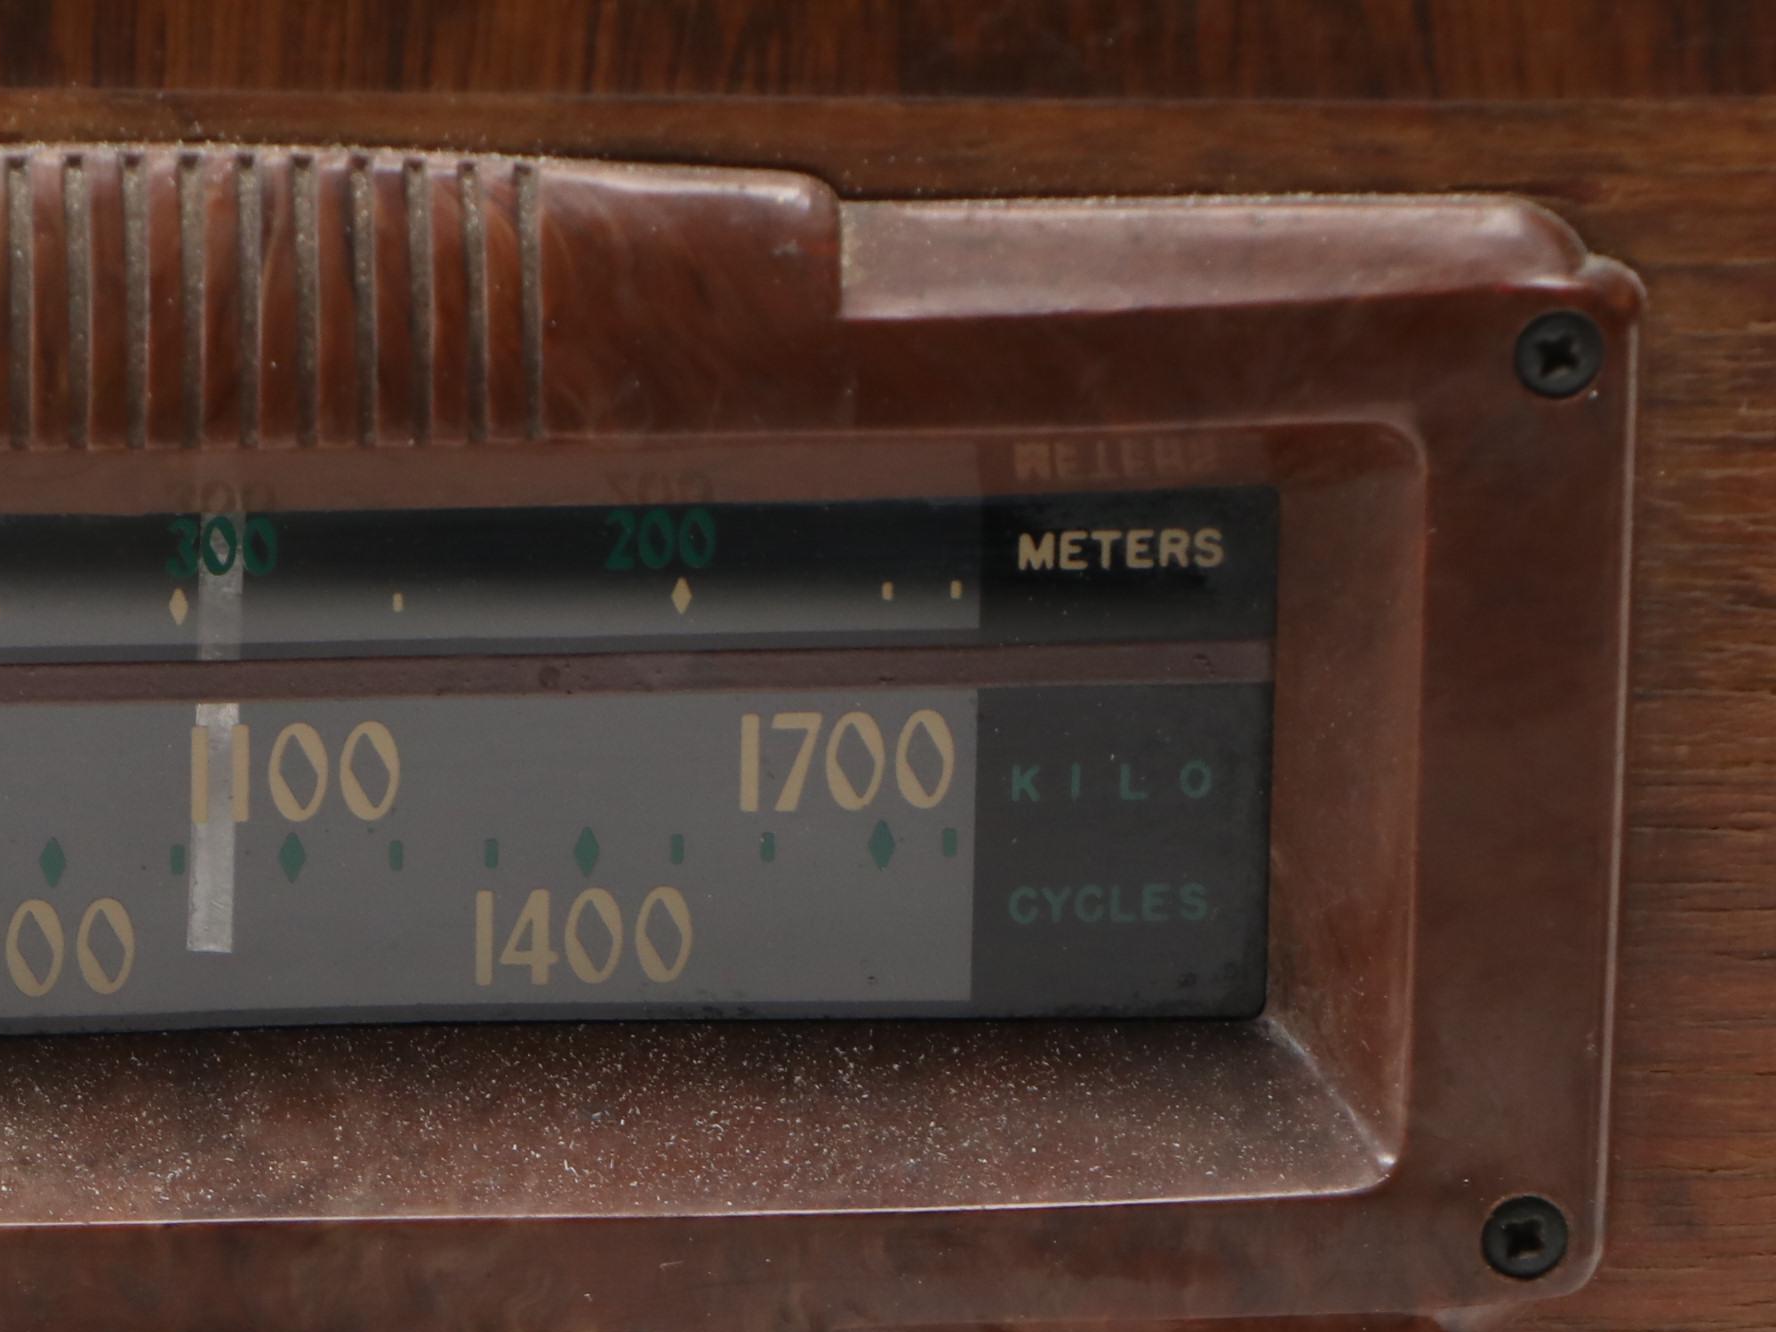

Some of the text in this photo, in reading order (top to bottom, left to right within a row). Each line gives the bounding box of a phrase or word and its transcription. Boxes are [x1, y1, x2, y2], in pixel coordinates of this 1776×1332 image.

[165, 516, 279, 578] 300
[605, 508, 717, 571] 200
[1018, 528, 1224, 572] METERS
[190, 721, 400, 823] 1100
[739, 709, 955, 813] 1700
[476, 886, 693, 986] 1400
[1009, 883, 1208, 926] CYCLES
